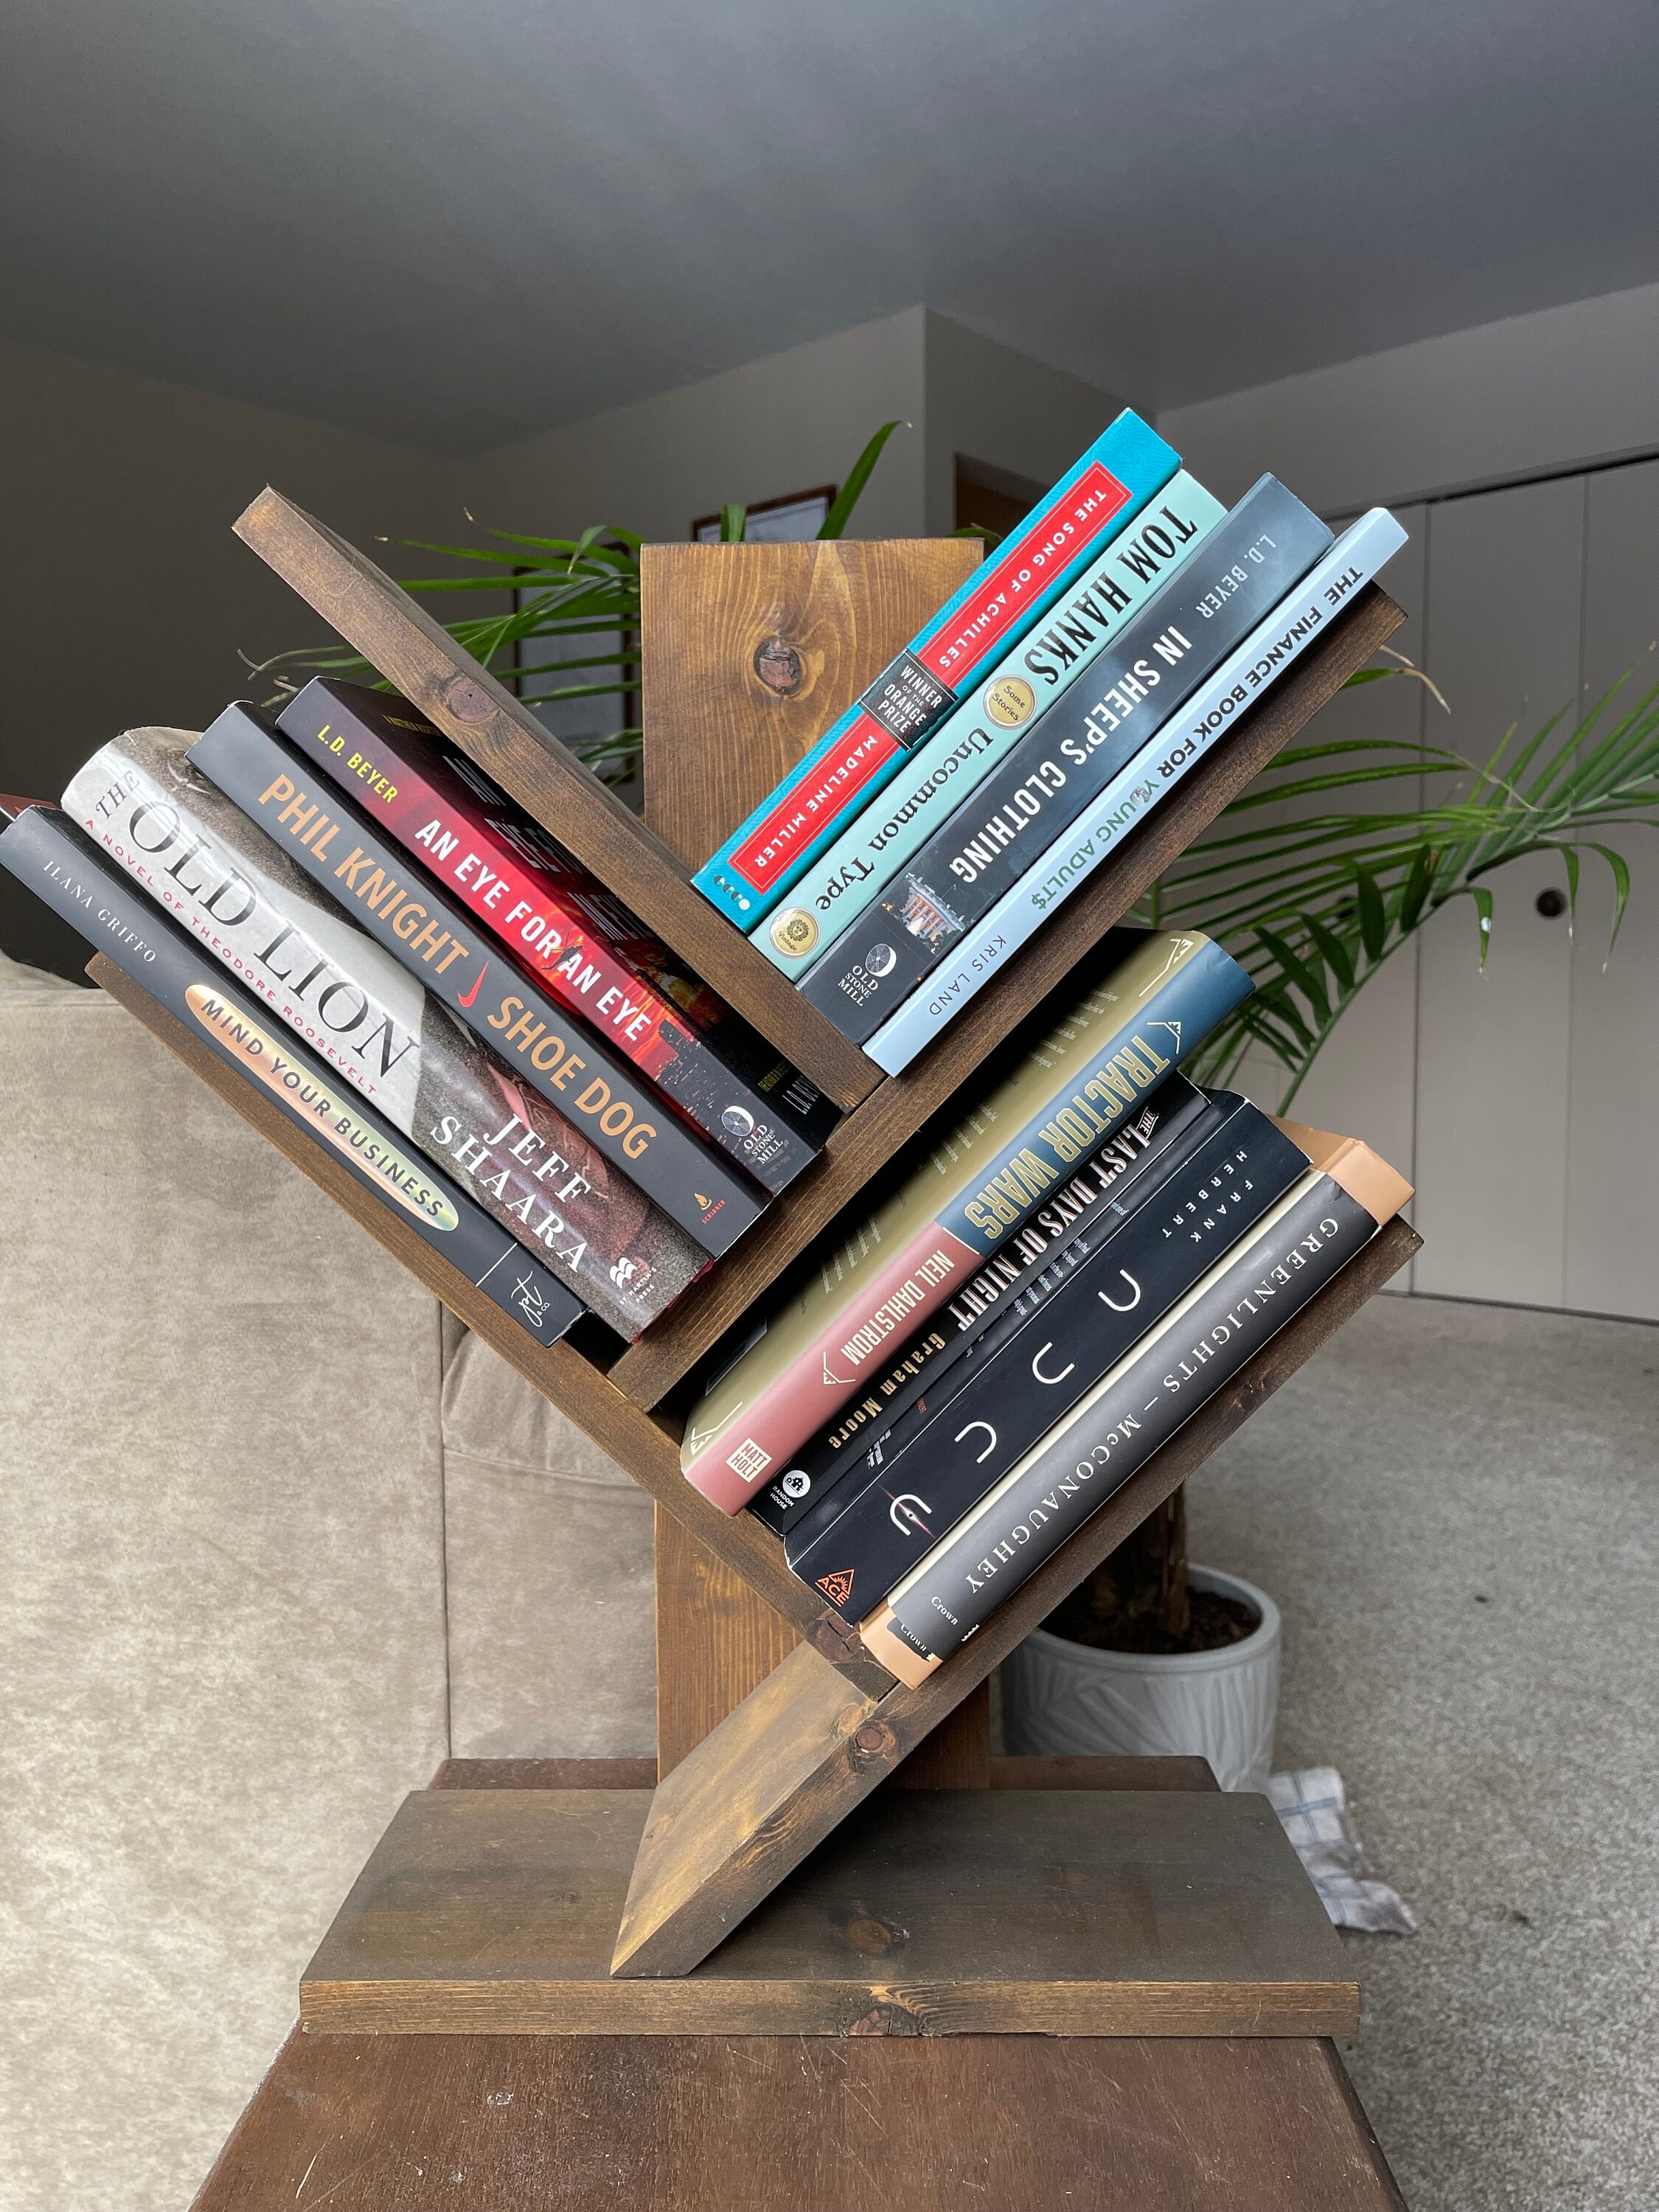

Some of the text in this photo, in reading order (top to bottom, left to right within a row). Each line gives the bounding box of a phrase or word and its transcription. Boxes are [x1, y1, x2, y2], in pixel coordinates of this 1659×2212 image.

[939, 490, 1106, 667] THE SONG OF ACHILLES
[1024, 505, 1198, 686] TOM HANKS
[1195, 534, 1277, 619] L.D. BEYER
[1324, 566, 1363, 606] THE
[1245, 605, 1324, 688] FINANCE
[878, 699, 911, 734] PRIZE
[884, 684, 927, 727] ORANGE
[901, 665, 942, 709] WINNER
[902, 685, 925, 706] OF THE
[992, 693, 1019, 721] Stories
[1004, 685, 1026, 709] Some
[1192, 684, 1249, 742] BOOK
[317, 725, 345, 757] L.D.
[347, 753, 398, 803] BEYER
[949, 625, 1192, 883] IN SHEEP'S CLOTHING
[1156, 737, 1197, 778] FOR
[95, 771, 140, 819] THE
[754, 735, 878, 868] MADELINE MILLER
[815, 728, 994, 910] Uncommon Type
[43, 861, 156, 962] ILANA GRIFFO
[129, 801, 420, 1078] OLD LION
[414, 819, 652, 1041] AN EYE FOR AN EYE
[779, 931, 797, 951] Vintage
[86, 819, 377, 1094] A NOVEL OF THEODORE ROOSEVELT
[258, 773, 657, 1159] PHIL KNIGHT SHOE DOG
[845, 973, 872, 998] STONE
[852, 965, 879, 991] OLD
[928, 935, 1007, 1016] KRIS LAND
[838, 978, 865, 1006] MILL
[201, 999, 443, 1217] MIND YOUR BUSINESS
[743, 1124, 768, 1150] OLD
[964, 1035, 1171, 1239] TRACTOR WARS
[483, 1113, 591, 1203] JEFF
[752, 1132, 775, 1157] STONE
[757, 1139, 784, 1165] MILL
[430, 1116, 588, 1273] SHAARA
[1162, 1150, 1248, 1238] HERBERT
[1190, 1180, 1253, 1243] FRANK
[947, 1123, 1152, 1332] LAST DAYS OF NIGHT
[636, 1284, 655, 1304] PRESS
[840, 1250, 955, 1366] NEIL DAHLSTROM
[1163, 1218, 1338, 1394] GREENLIGHTS
[828, 1332, 946, 1449] Graham Moore
[731, 1453, 758, 1479] HOLT
[740, 1443, 768, 1469] MATT
[770, 1492, 787, 1510] HOUSE
[772, 1486, 795, 1507] RANDOM
[965, 1413, 1142, 1593] McCONAUGHEY
[817, 1576, 849, 1605] ACE
[931, 1596, 959, 1626] Crown
